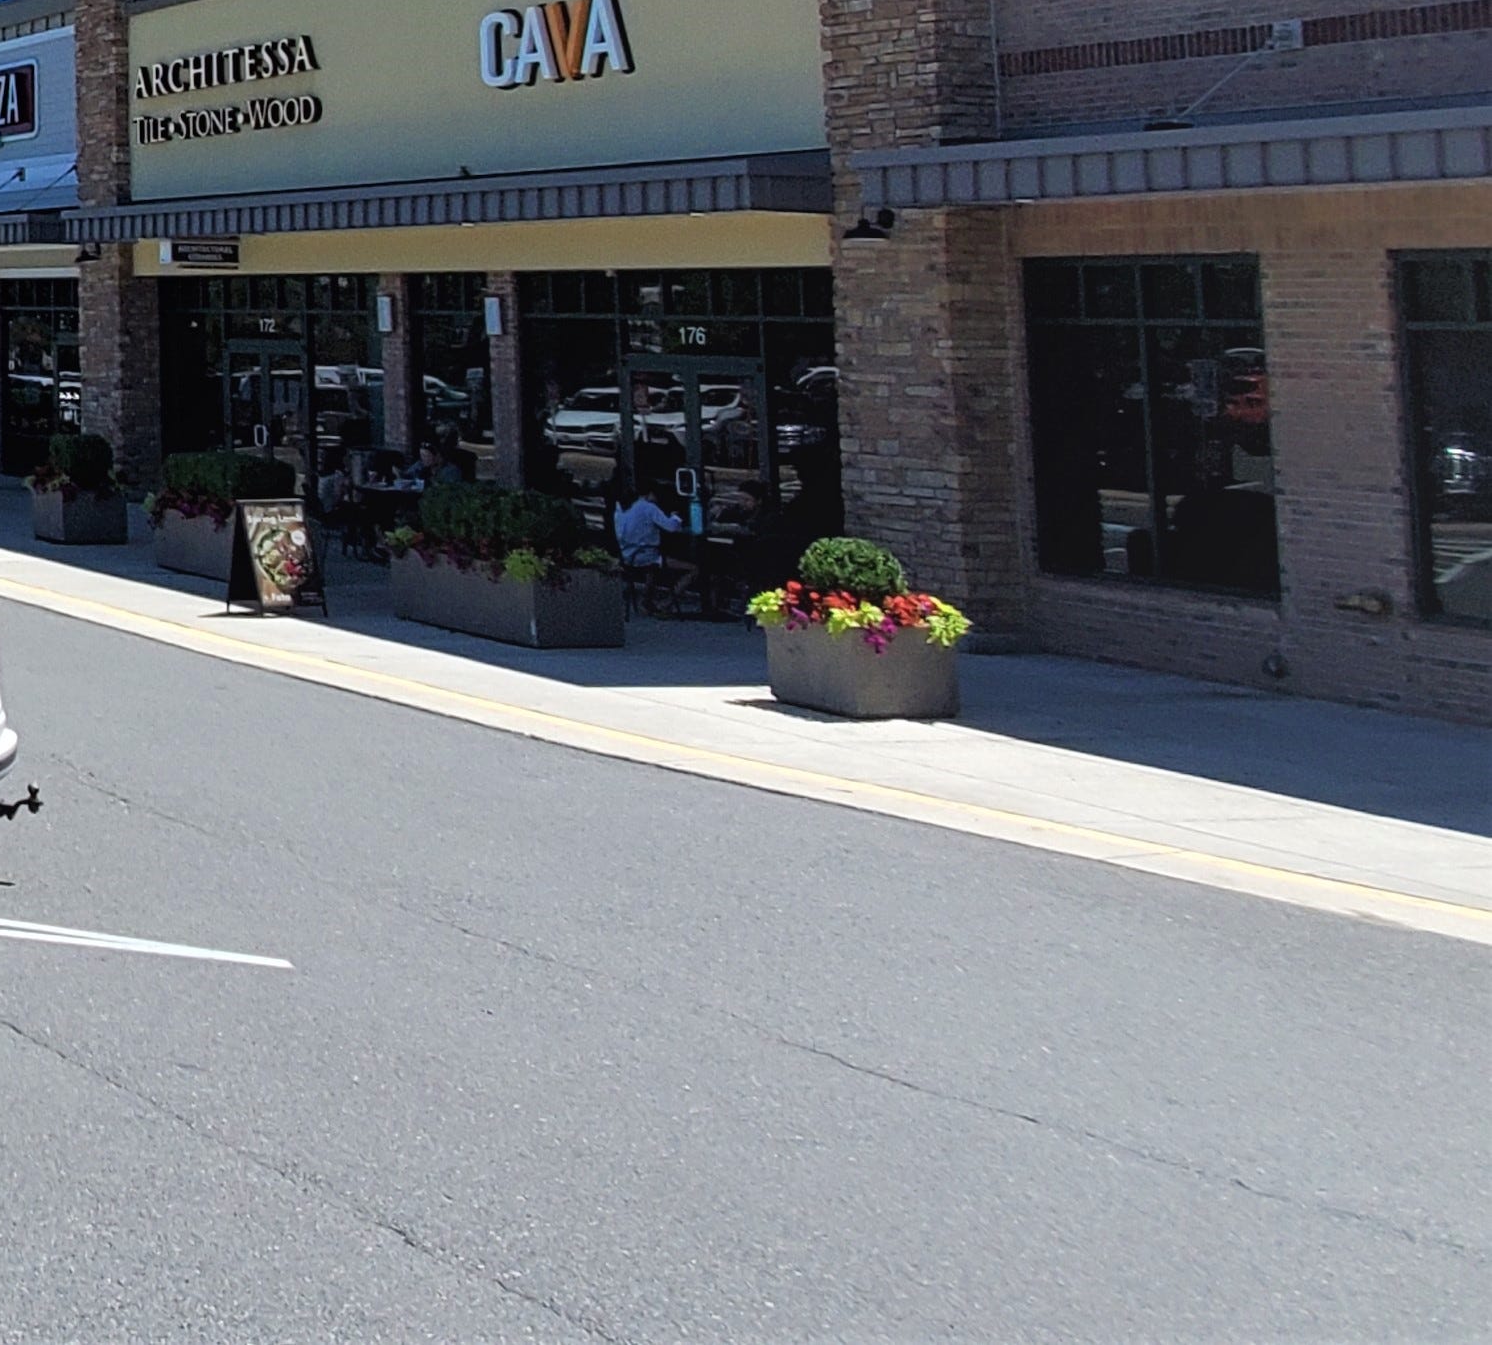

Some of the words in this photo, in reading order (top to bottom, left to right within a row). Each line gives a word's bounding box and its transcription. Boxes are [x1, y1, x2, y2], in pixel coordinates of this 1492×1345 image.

[134, 35, 316, 99] ARCHITESSA
[258, 318, 276, 332] 172
[678, 327, 706, 345] 176
